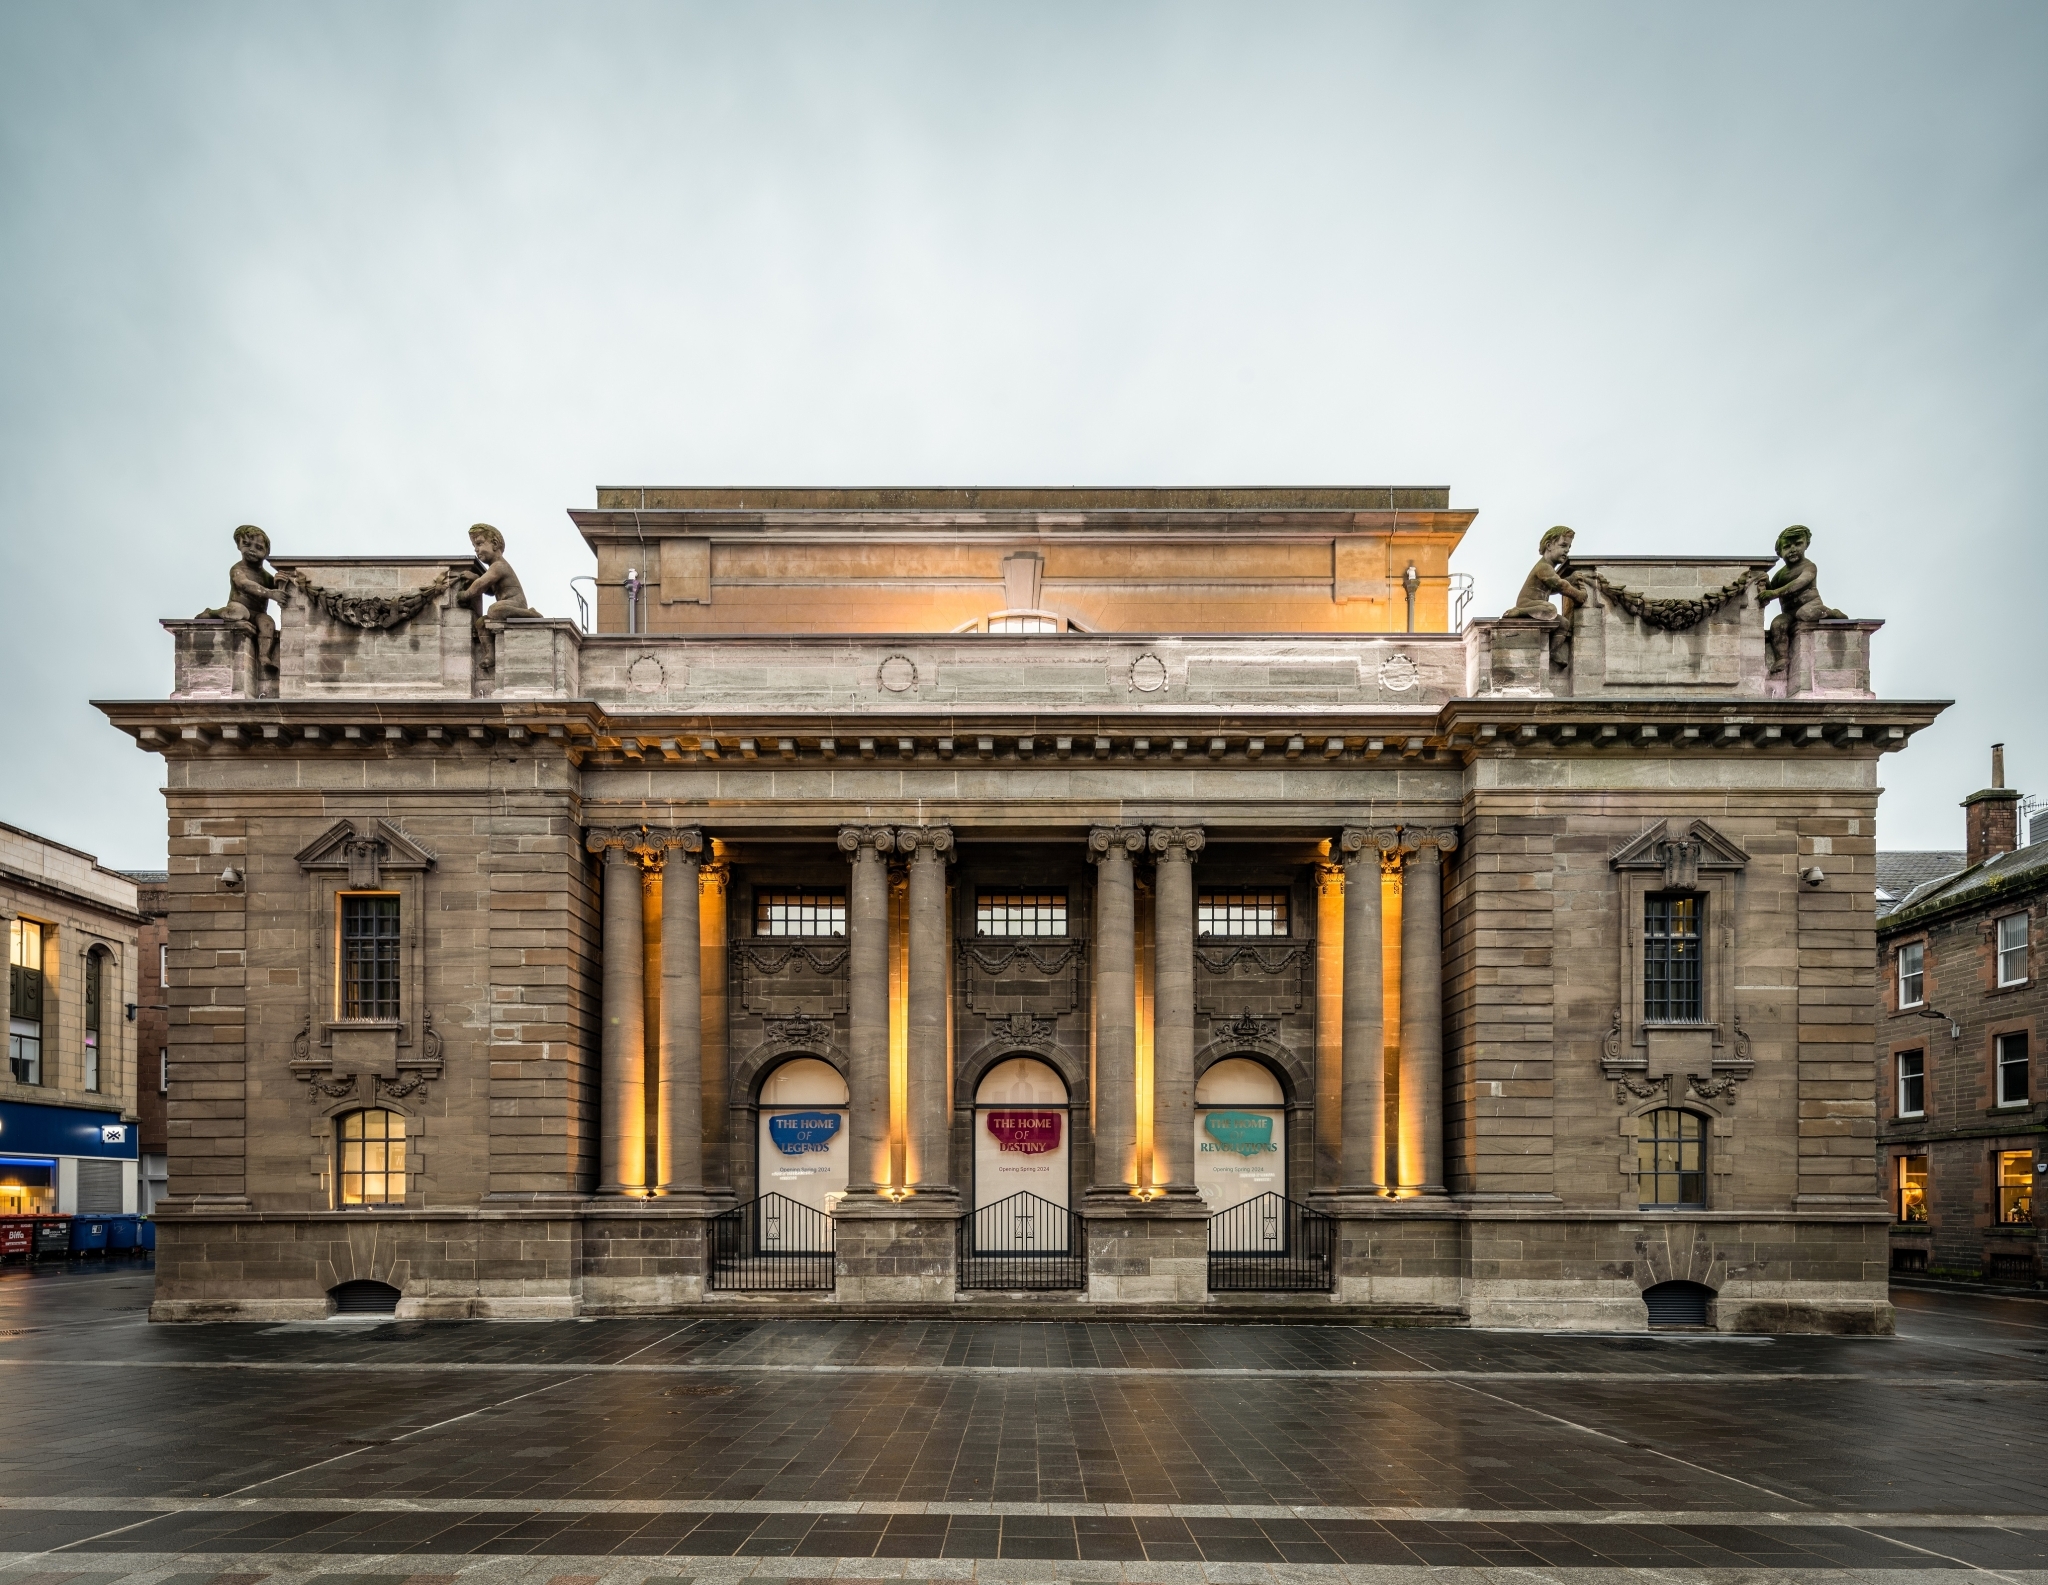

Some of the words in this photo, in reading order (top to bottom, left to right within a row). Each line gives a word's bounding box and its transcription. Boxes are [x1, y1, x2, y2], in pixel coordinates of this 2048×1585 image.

[776, 1119, 798, 1129] THE
[800, 1119, 834, 1129] HOME
[993, 1118, 1016, 1128] THE
[1018, 1118, 1052, 1128] HOME
[1210, 1119, 1231, 1129] THE
[1233, 1119, 1268, 1129] HOME
[797, 1131, 813, 1140] OF
[1014, 1130, 1030, 1140] OF
[781, 1142, 829, 1152] LEGENDS
[1000, 1142, 1046, 1152] DESTINY
[1200, 1142, 1278, 1152] REVOLUTIONS
[9, 1230, 25, 1239] Biffa
